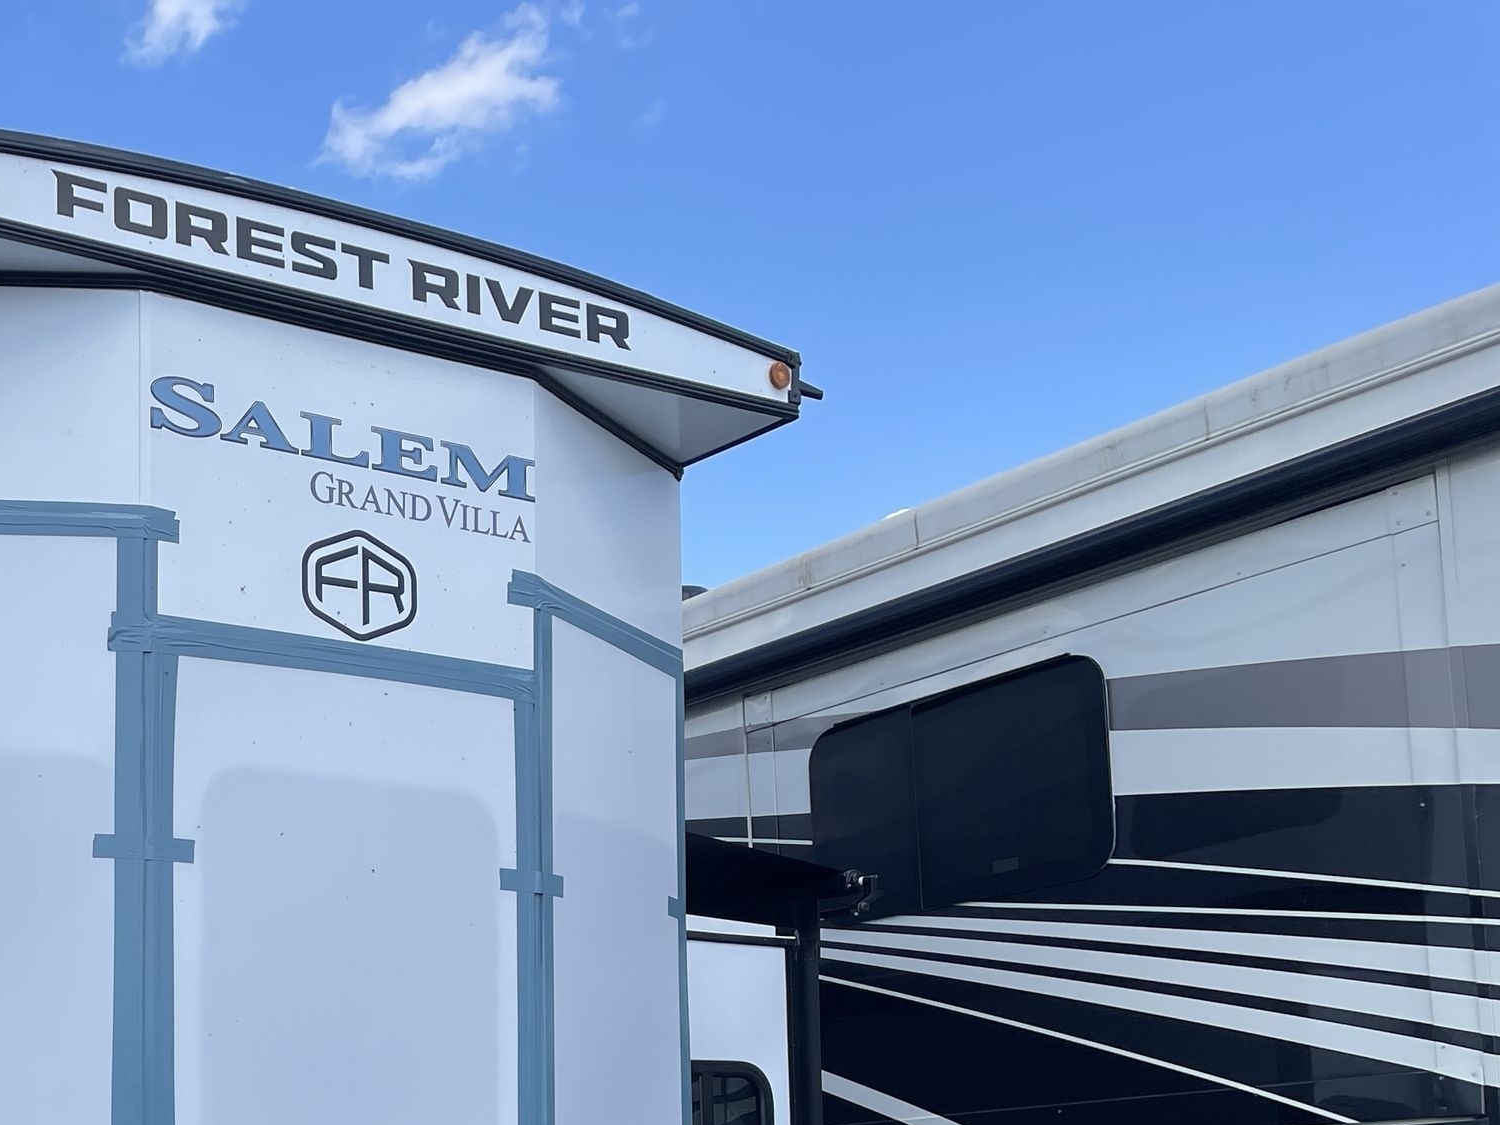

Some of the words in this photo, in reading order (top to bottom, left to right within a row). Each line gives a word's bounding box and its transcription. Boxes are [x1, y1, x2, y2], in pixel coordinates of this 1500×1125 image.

[50, 168, 390, 290] FOREST
[406, 258, 632, 351] RIVER
[150, 375, 536, 502] SALEM
[309, 471, 432, 522] GRAND
[436, 495, 532, 544] VILLA
